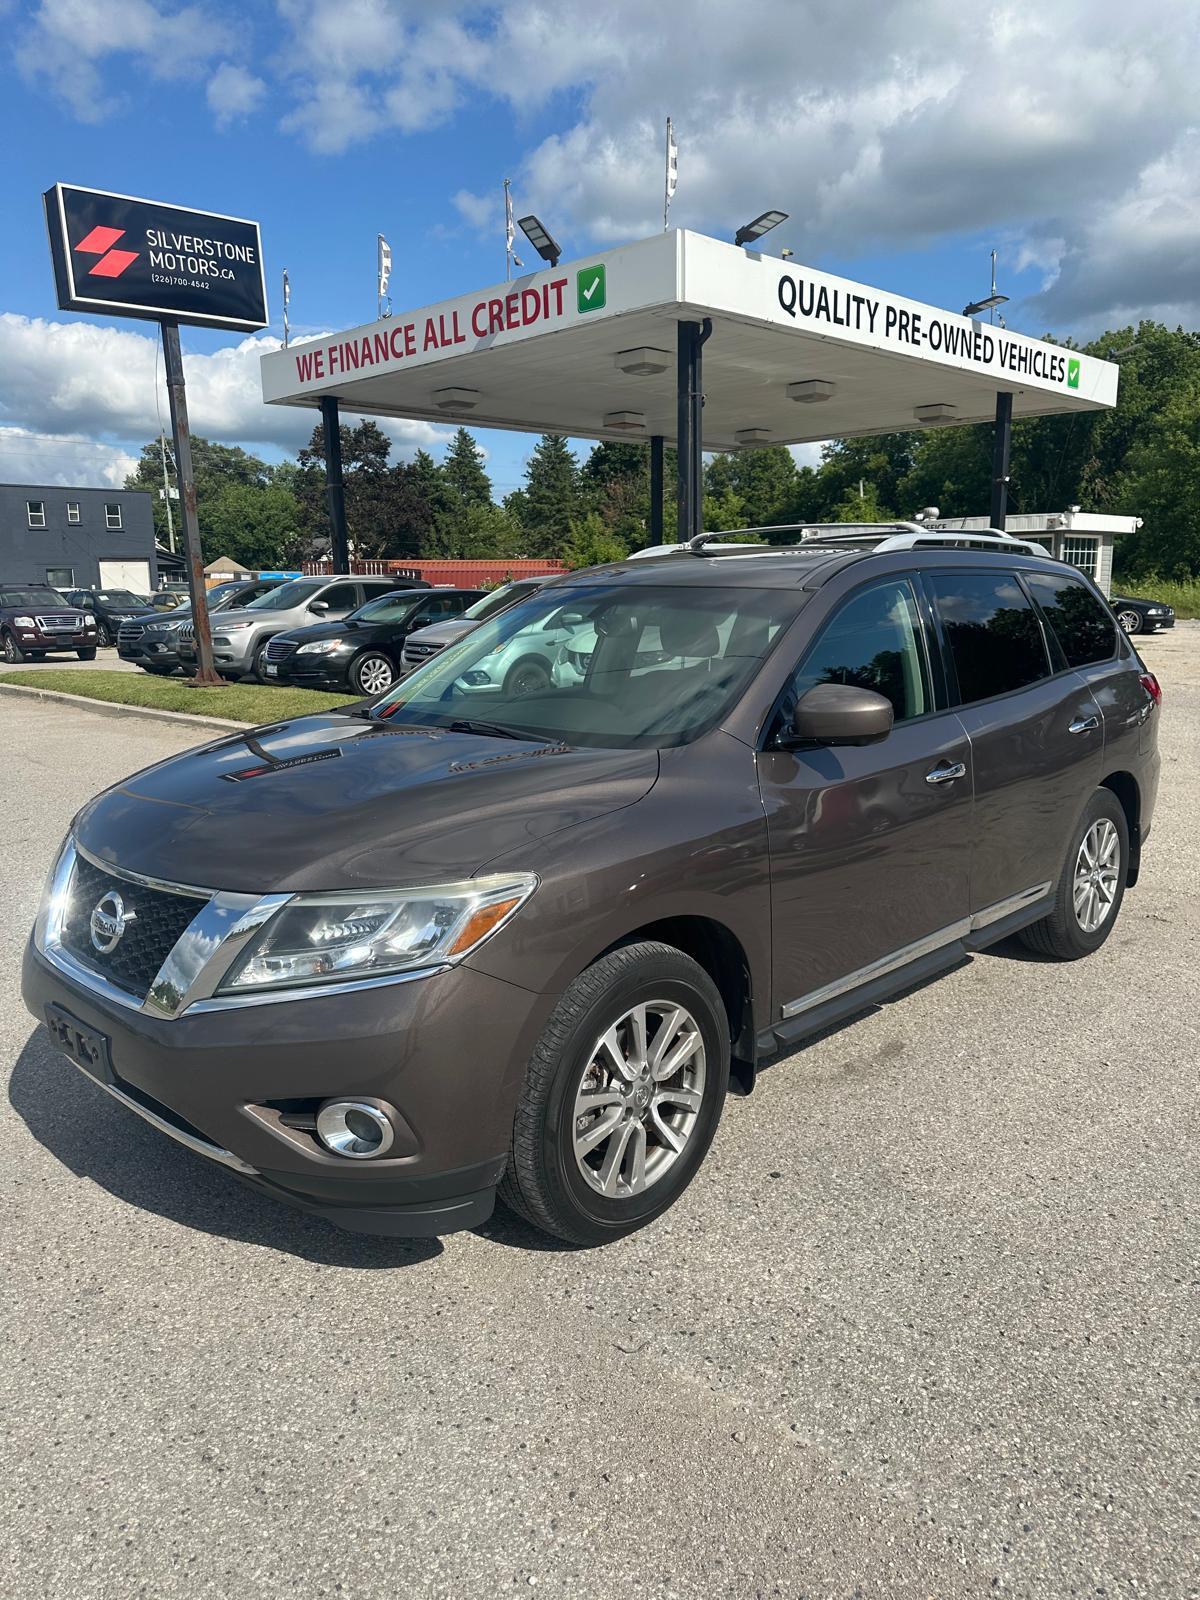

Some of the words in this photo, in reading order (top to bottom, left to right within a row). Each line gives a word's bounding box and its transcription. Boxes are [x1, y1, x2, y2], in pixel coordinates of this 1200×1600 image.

[146, 229, 256, 264] SILVERSTONE
[149, 250, 236, 280] MOTORS.CA
[151, 273, 210, 290] (226)700-4542
[296, 349, 325, 383] WE
[328, 323, 417, 375] FINANCE
[423, 311, 466, 351] ALL
[471, 278, 568, 338] CREDIT
[778, 275, 880, 333] QUALITY
[885, 305, 994, 364] PRE-OWNED
[999, 339, 1066, 383] VEHICLES
